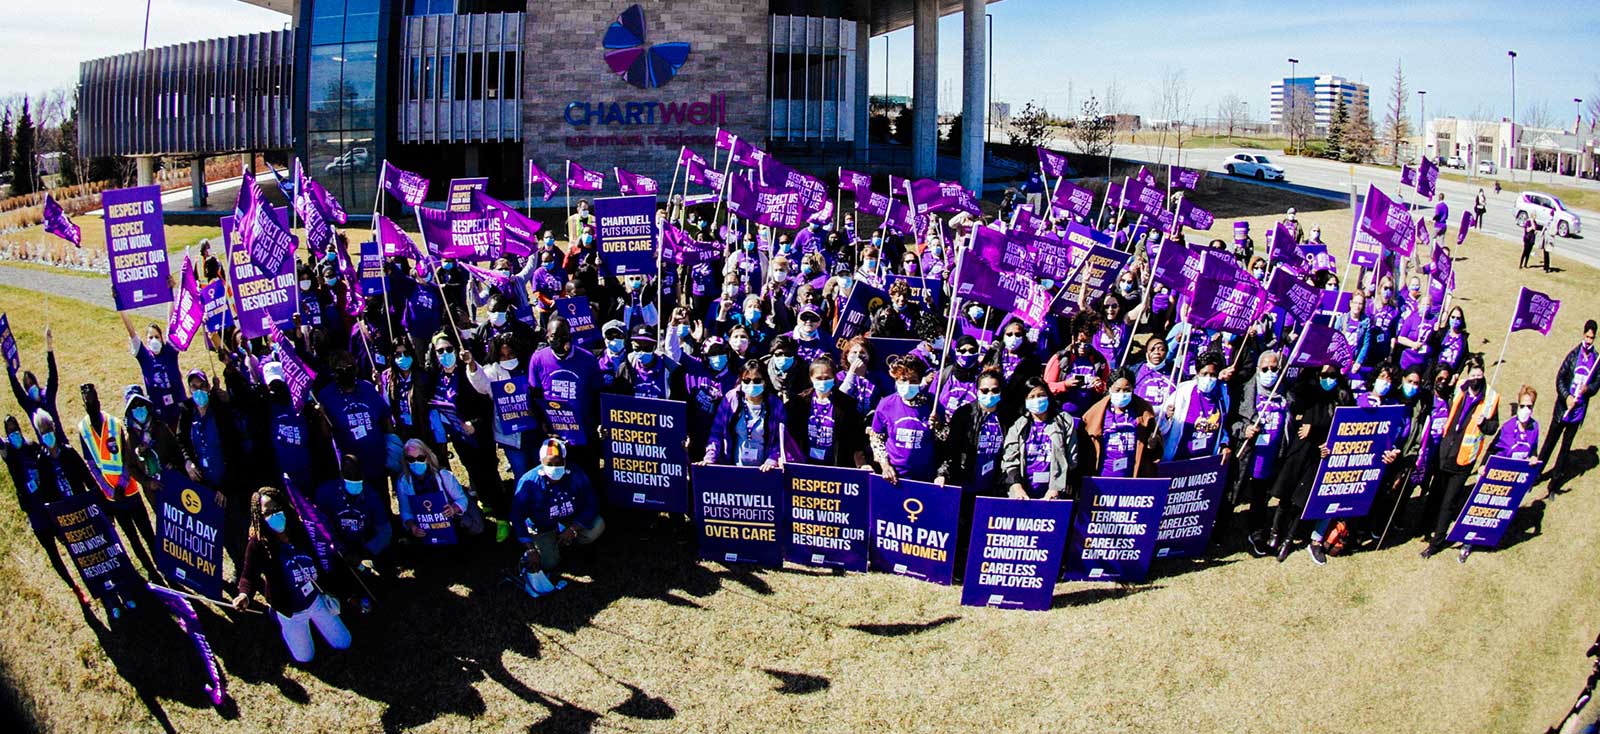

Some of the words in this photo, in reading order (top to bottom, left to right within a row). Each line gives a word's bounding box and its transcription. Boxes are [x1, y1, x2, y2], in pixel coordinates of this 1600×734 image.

[564, 93, 727, 126] CHARTwell
[788, 171, 814, 188] RESPECT
[758, 193, 788, 205] RESPECT
[108, 204, 142, 219] RESPECT
[143, 201, 154, 214] US
[756, 203, 786, 214] PROTECT
[601, 214, 651, 226] CHARTWELL
[770, 213, 785, 223] PAY
[110, 221, 144, 237] RESPECT
[452, 219, 487, 233] RESPECT
[601, 226, 619, 236] PUTS
[621, 225, 651, 236] PROFITS
[112, 236, 128, 251] OUR
[129, 234, 152, 249] WORK
[452, 233, 488, 246] PROTECT
[602, 242, 628, 253] OVER
[629, 240, 652, 252] CARE
[253, 242, 269, 264] PAY
[474, 244, 489, 256] PAY
[114, 252, 149, 269] RESPECT
[149, 250, 165, 263] OUR
[1088, 255, 1113, 267] RESPECT
[116, 265, 158, 283] RESIDENTS
[235, 263, 254, 279] OUR
[238, 278, 276, 298] RESPECT
[277, 273, 296, 288] OUR
[241, 289, 289, 311] RESIDENTS
[1013, 295, 1029, 312] PAY
[579, 316, 592, 326] PAY
[847, 310, 865, 325] NOT
[1287, 367, 1299, 378] FOR
[498, 395, 510, 405] NOT
[510, 396, 516, 404] A
[515, 393, 527, 403] DAY
[500, 401, 528, 413] WITHOUT
[503, 412, 520, 422] EQUAL
[550, 415, 577, 424] WITHOUT
[610, 409, 657, 426] RESPECT
[659, 416, 674, 429] US
[1337, 422, 1377, 436] RESPECT
[1377, 421, 1391, 434] US
[611, 428, 657, 445] RESPECT
[611, 441, 633, 456] OUR
[634, 444, 667, 459] WORK
[1332, 441, 1373, 455] RESPECT
[613, 457, 658, 473] RESPECT
[660, 464, 682, 477] OUR
[1328, 455, 1347, 468] OUR
[1348, 453, 1375, 467] WORK
[613, 470, 670, 488] RESIDENTS
[1169, 476, 1187, 490] OW
[1187, 472, 1218, 486] WAGES
[1323, 471, 1362, 484] RESPECT
[1361, 468, 1380, 481] OUR
[1487, 469, 1518, 482] RESPECT
[1516, 472, 1528, 483] US
[792, 478, 842, 494] RESPECT
[843, 483, 859, 496] US
[1318, 483, 1365, 496] RESIDENTS
[1479, 484, 1512, 496] RESPECT
[702, 491, 775, 508] CHARTWELL
[792, 495, 841, 511] RESPECT
[1093, 495, 1118, 508] LOW
[1118, 495, 1155, 508] WAGES
[1167, 488, 1204, 504] ERRIBLE
[1474, 494, 1490, 505] OUR
[1489, 496, 1512, 507] WORK
[57, 509, 88, 526] RESPECT
[88, 505, 100, 519] US
[417, 513, 433, 522] FAIR
[703, 507, 730, 519] PUTS
[732, 508, 775, 521] PROFITS
[792, 507, 815, 521] OUR
[816, 510, 849, 525] WORK
[1090, 511, 1138, 524] TERRIBLE
[1468, 506, 1498, 518] RESPECT
[1496, 509, 1513, 520] OUR
[163, 502, 184, 525] NOT
[186, 515, 195, 528] A
[196, 519, 218, 543] DAY
[419, 522, 430, 530] FOR
[430, 520, 451, 529] WOMEN
[988, 517, 1014, 530] LOW
[1015, 518, 1056, 532] WAGES
[1087, 523, 1147, 535] CONDITIONS
[1461, 515, 1501, 529] RESIDENTS
[66, 525, 96, 543] RESPECT
[705, 525, 739, 539] OVER
[741, 527, 776, 541] CARE
[792, 522, 840, 538] RESPECT
[842, 528, 865, 541] OUR
[876, 519, 914, 541] FAIR
[916, 528, 949, 549] PAY
[1156, 525, 1204, 541] MPLOYERS
[71, 541, 86, 554] OUR
[86, 534, 107, 550] WORK
[163, 519, 215, 561] WITHOUT
[792, 534, 851, 550] RESIDENTS
[986, 534, 1039, 548] TERRIBLE
[1084, 537, 1135, 549] CARELESS
[78, 549, 109, 568] RESPECT
[107, 542, 123, 557] OUR
[876, 536, 899, 552] FOR
[901, 542, 947, 562] WOMEN
[983, 547, 1049, 562] CONDITIONS
[1081, 549, 1141, 561] EMPLOYERS
[163, 541, 195, 568] EQUAL
[196, 554, 217, 577] PAY
[85, 559, 121, 578] RESIDENTS
[980, 562, 1037, 576] CARELESS
[978, 575, 1043, 589] EMPLOYERS
